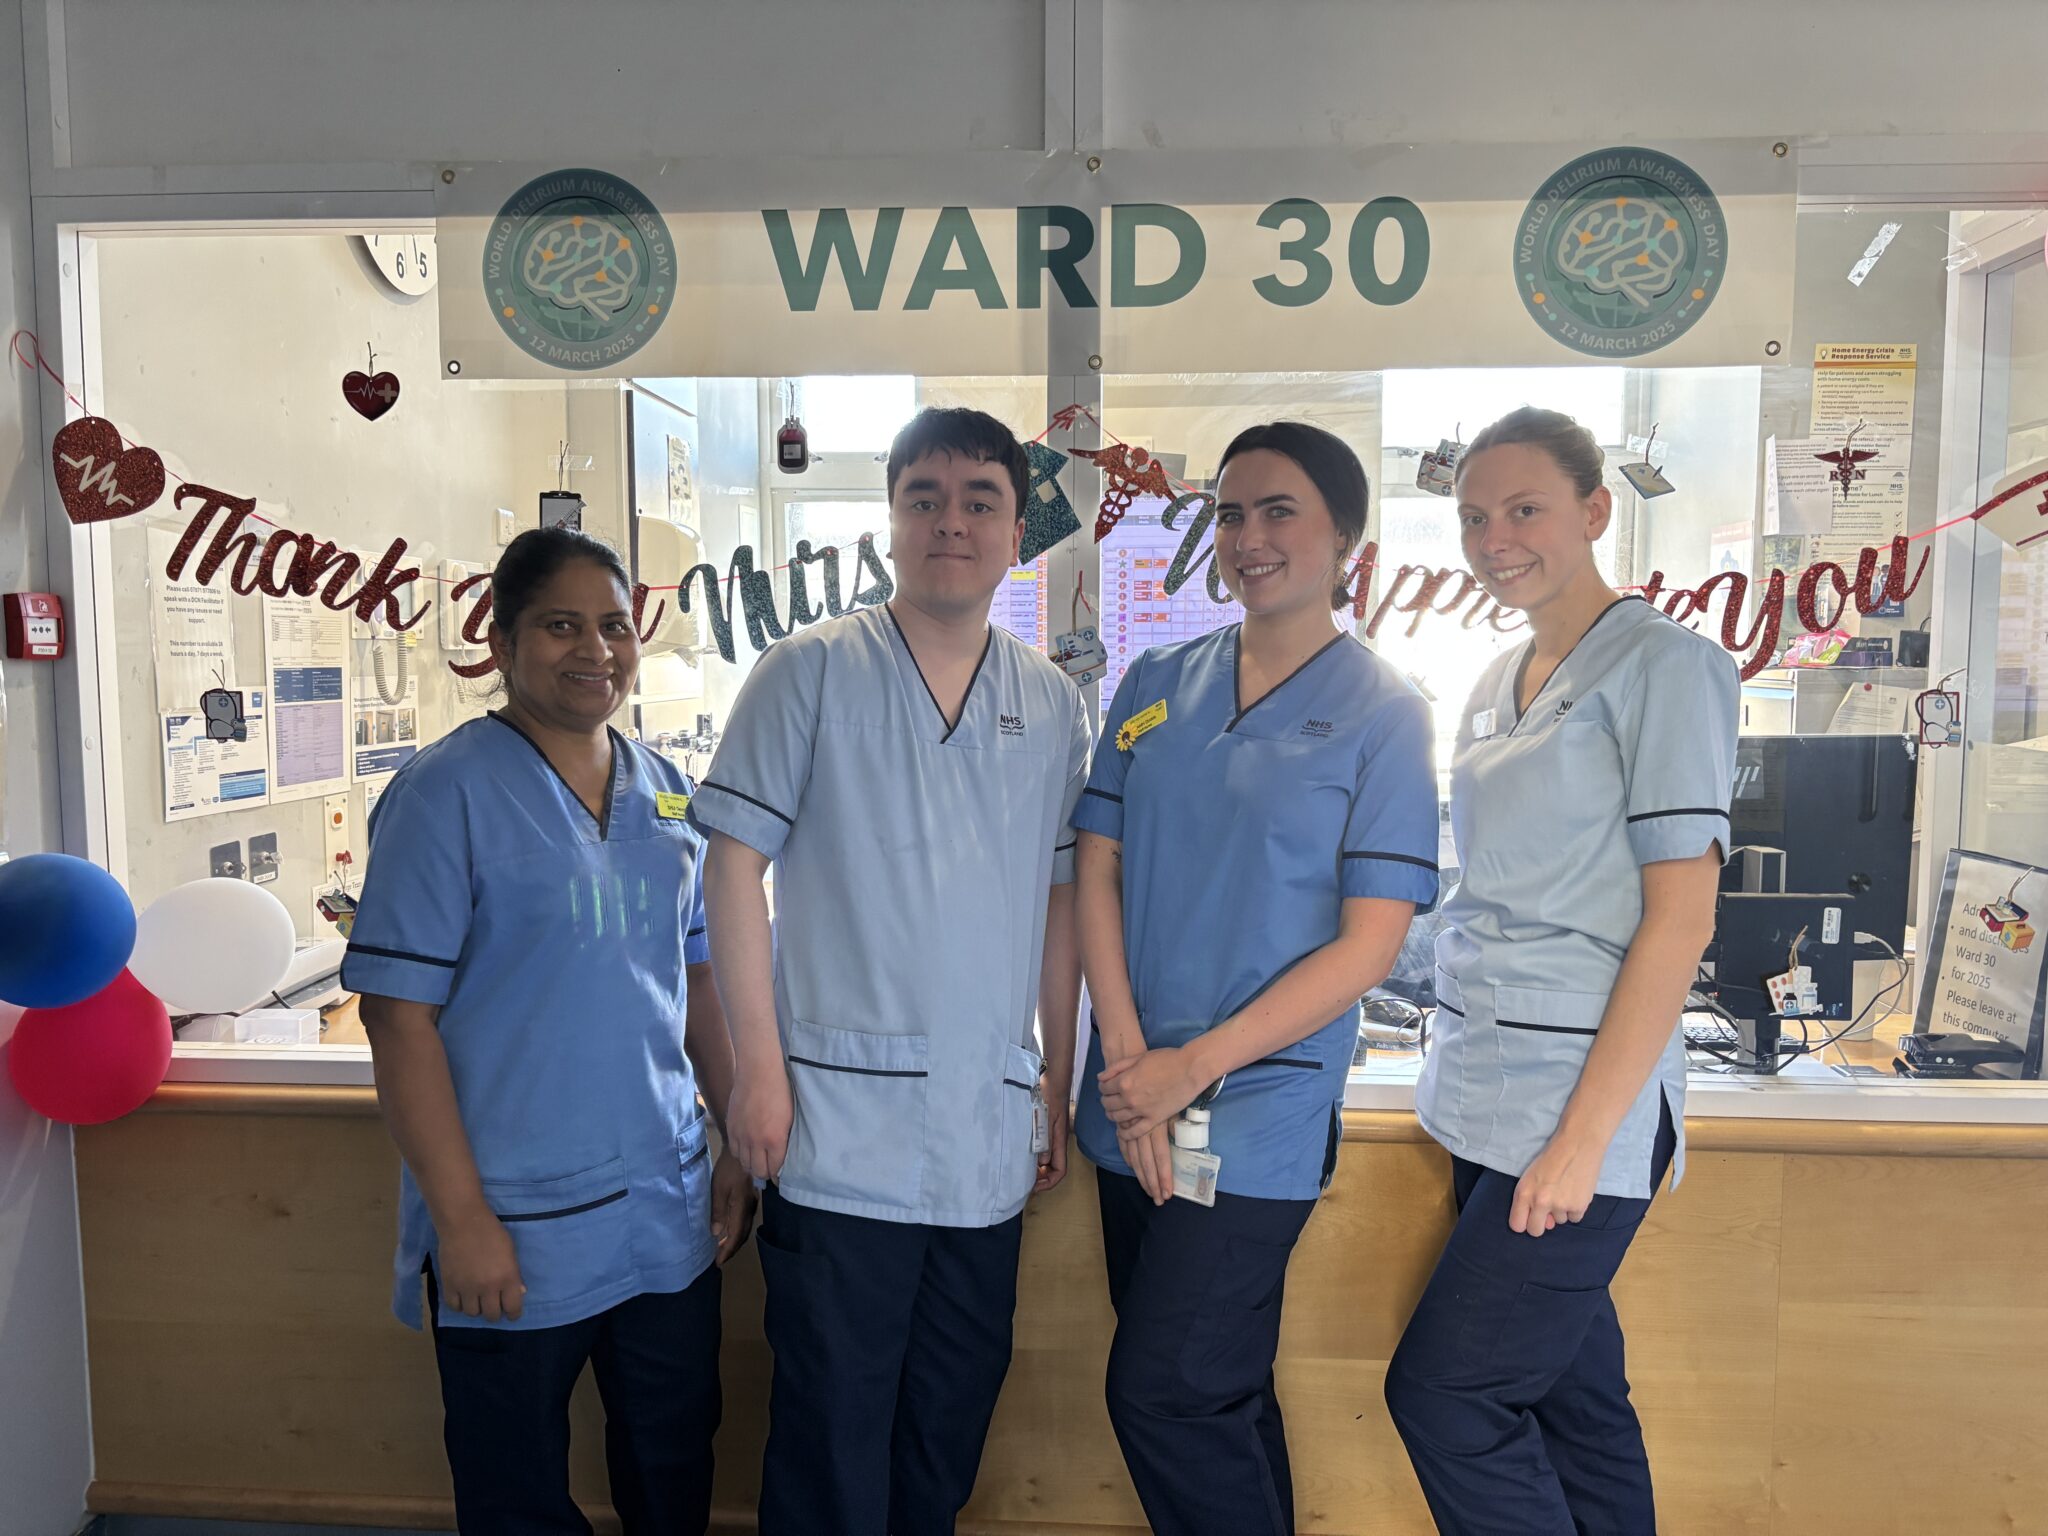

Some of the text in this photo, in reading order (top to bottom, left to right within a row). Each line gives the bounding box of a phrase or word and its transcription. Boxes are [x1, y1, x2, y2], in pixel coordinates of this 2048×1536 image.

[1519, 157, 1719, 264] WORLD DELIRIUM AWARENESS DAY
[488, 178, 670, 279] WORLD DELIRIUM AWARENESS DAY
[396, 251, 428, 279] 6 5
[761, 196, 1430, 312] WARD 30
[529, 334, 635, 363] 12 MARCH 2025
[1559, 320, 1676, 351] 12 MARCH 2025
[1831, 353, 1866, 361] Response
[1852, 347, 1875, 355] Energy
[166, 482, 432, 632] Thank
[1695, 535, 1931, 683] You
[1000, 714, 1022, 726] NHS
[1306, 719, 1333, 729] NHS
[1958, 924, 1977, 941] and
[1956, 945, 1996, 969] Ward 30
[1951, 966, 1991, 990] for 2025
[1942, 1011, 1961, 1028] this
[1946, 990, 2017, 1025] Please leave at
